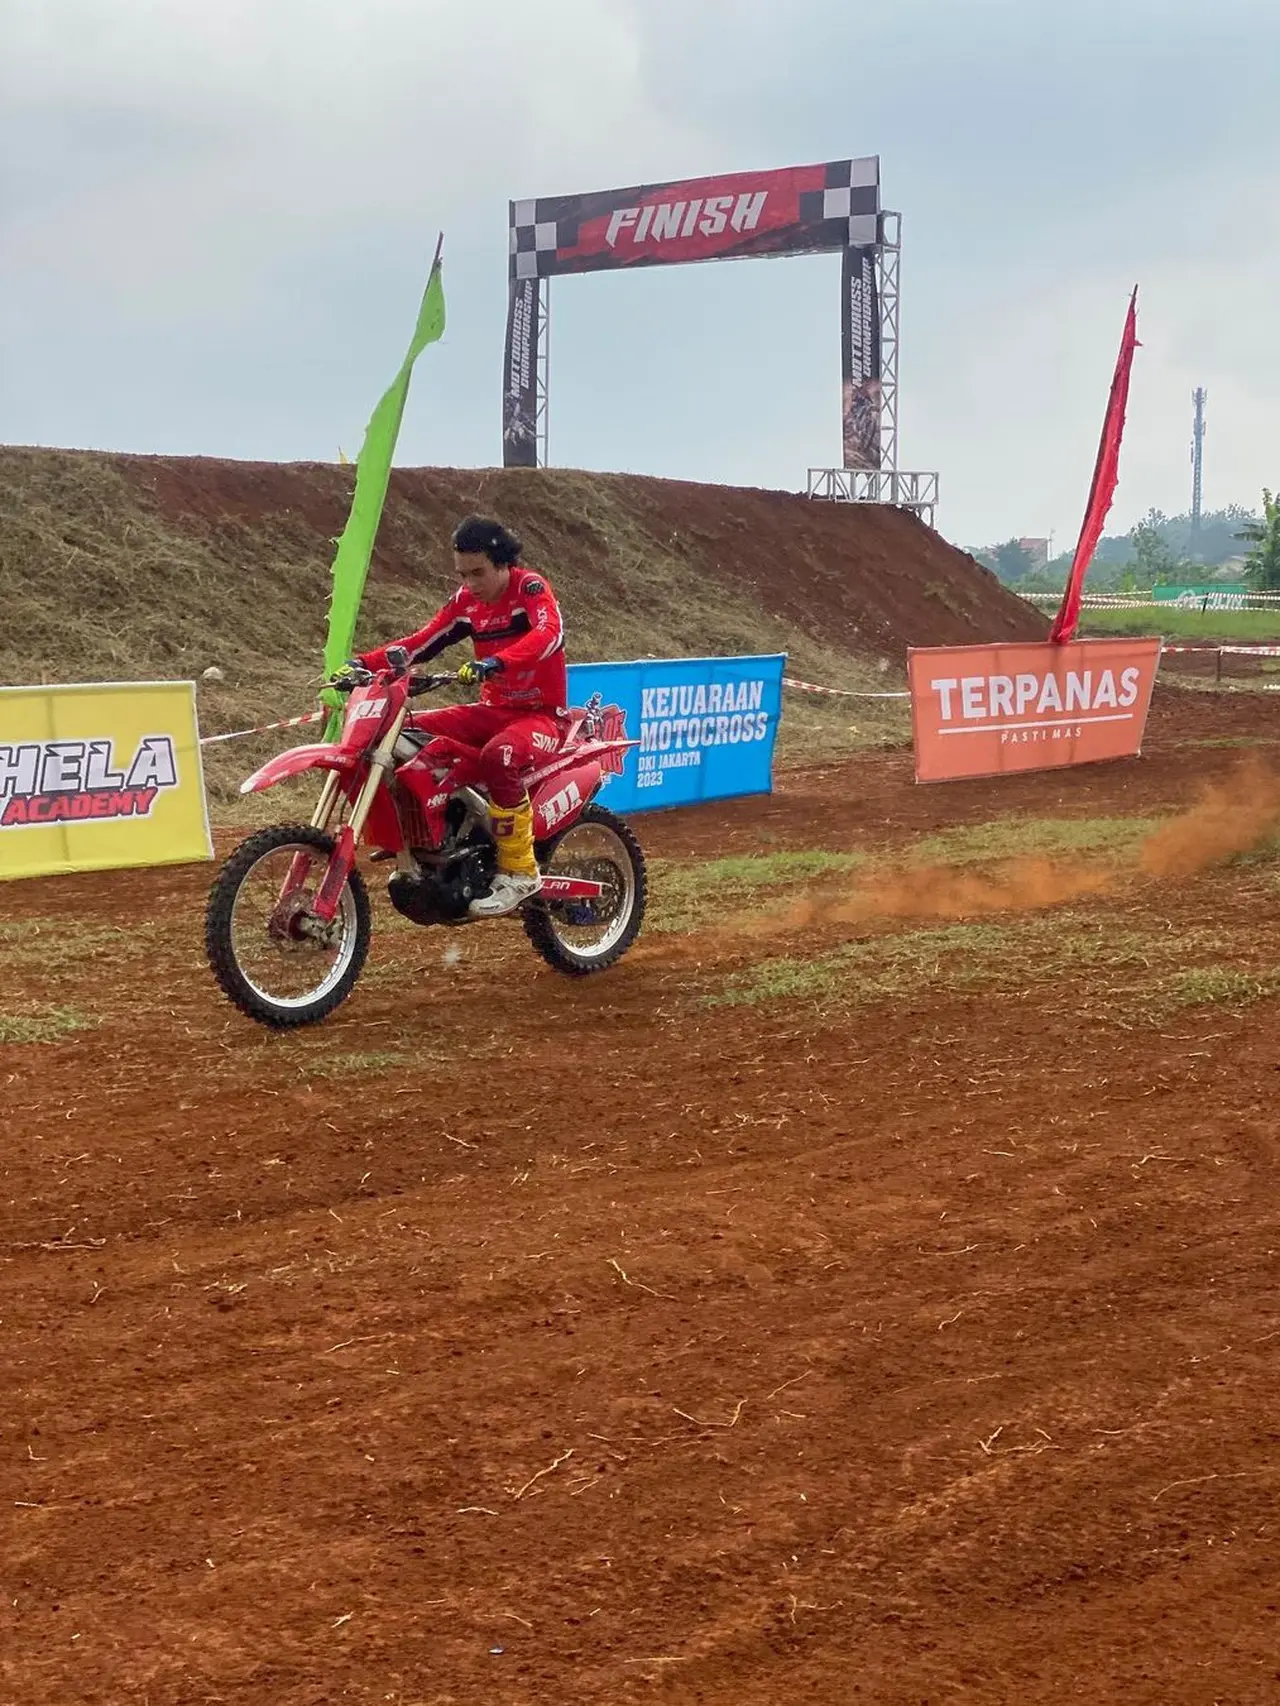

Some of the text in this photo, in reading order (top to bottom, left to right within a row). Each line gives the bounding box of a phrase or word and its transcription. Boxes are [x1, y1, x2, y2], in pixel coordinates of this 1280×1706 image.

[605, 190, 770, 248] FINISH
[520, 280, 534, 390] CHAMPIONSHIP
[851, 276, 863, 389] MOTOCROSS
[861, 257, 873, 378] CHAMPIONSHIP
[510, 296, 524, 399] MOTOCROSS
[641, 680, 765, 719] KEJUARAAN
[931, 666, 1141, 720] TERPANAS
[638, 711, 769, 753] MOTOCROSS
[636, 770, 664, 788] 2023
[637, 750, 701, 772] DKI JAKARTA
[1, 786, 159, 826] ACADEMY
